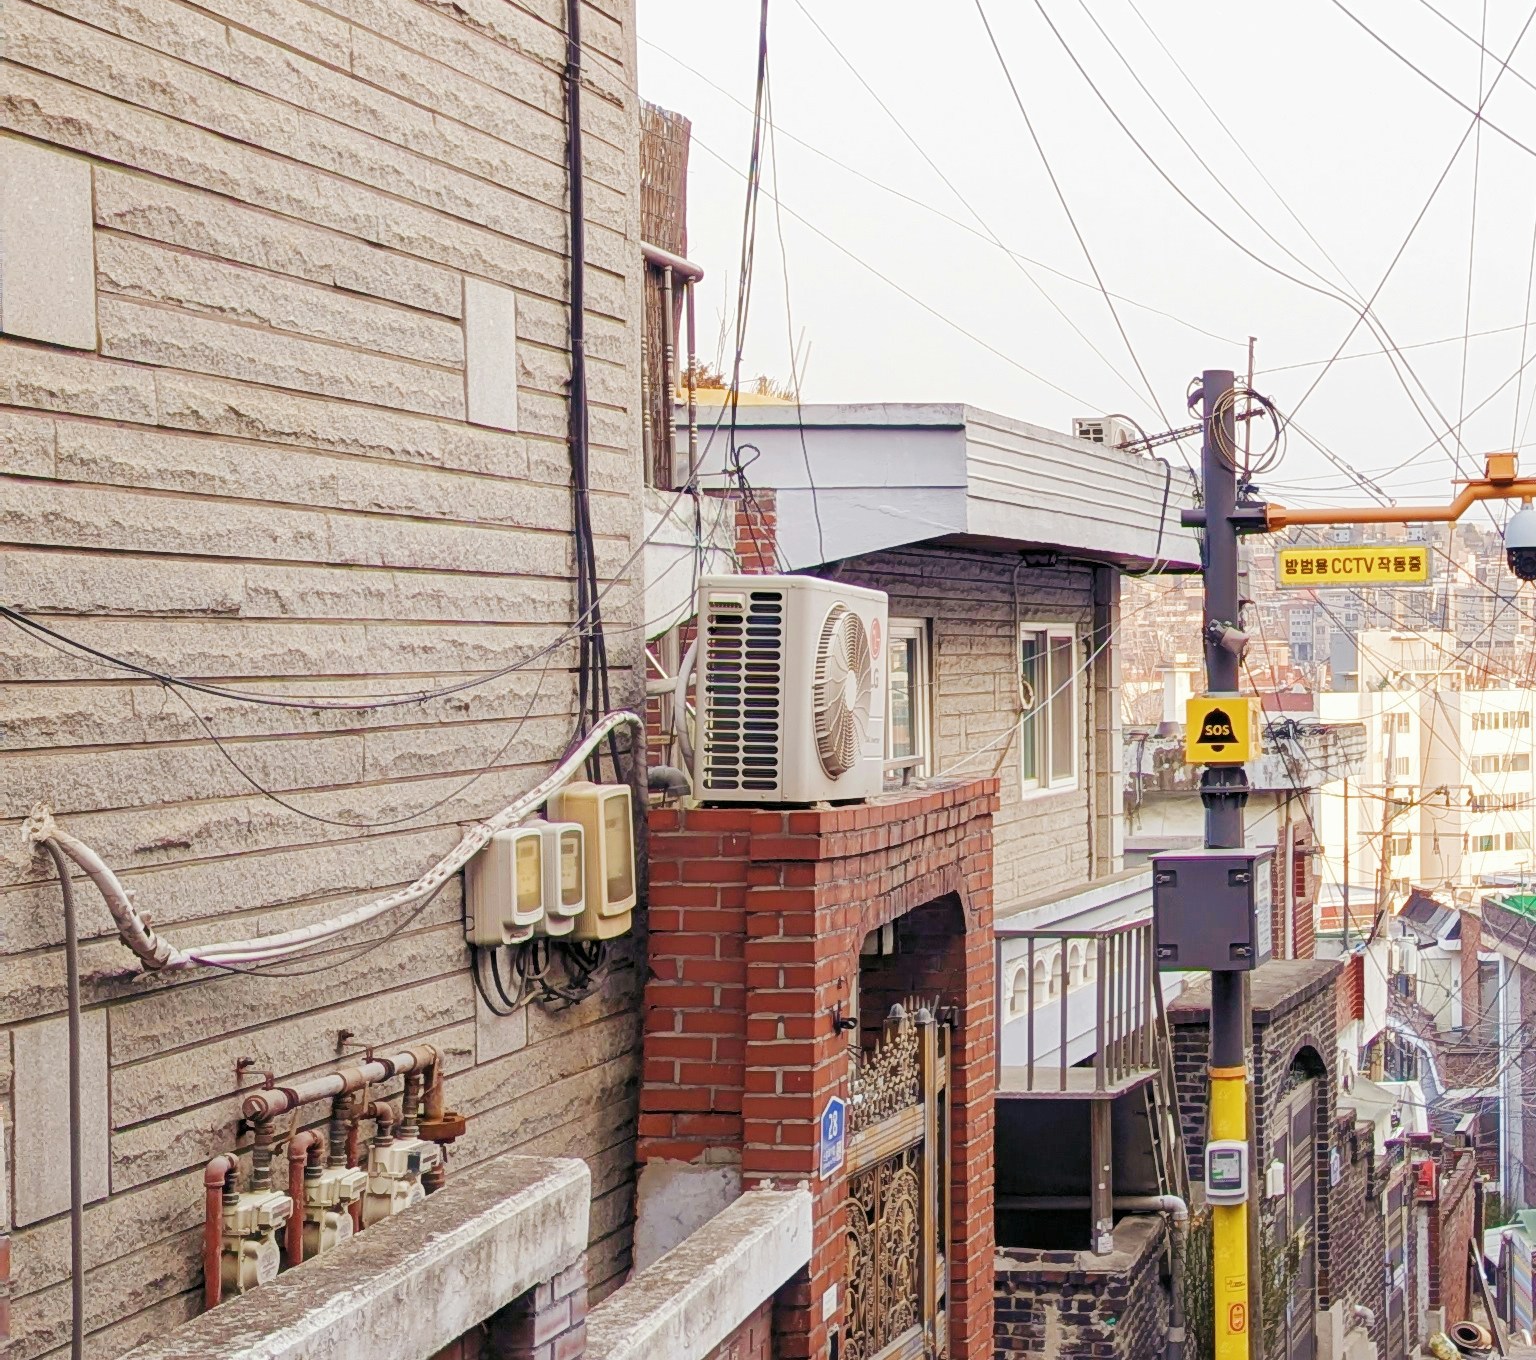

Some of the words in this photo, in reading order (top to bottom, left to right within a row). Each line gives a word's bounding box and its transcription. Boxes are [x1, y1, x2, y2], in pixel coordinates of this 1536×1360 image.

[1285, 558, 1328, 575] 방범용
[1331, 557, 1375, 574] CCTV
[1377, 556, 1422, 573] 작동중
[1204, 724, 1231, 736] SOS
[828, 1110, 838, 1140] 28
